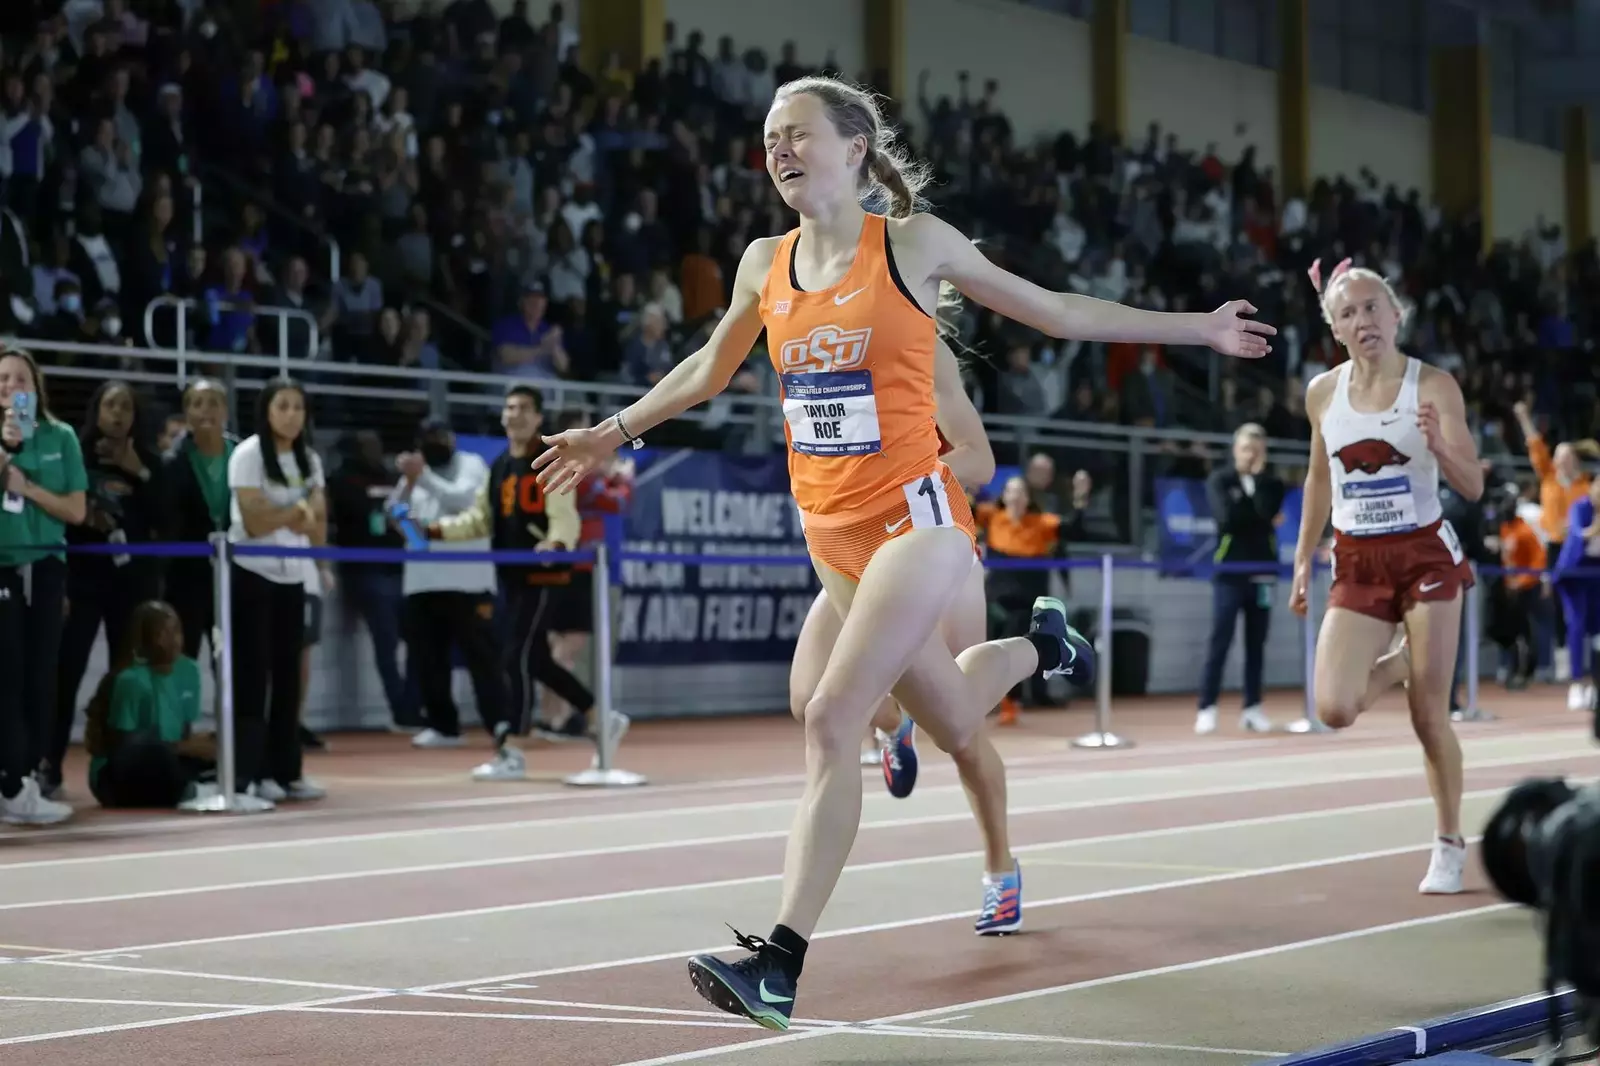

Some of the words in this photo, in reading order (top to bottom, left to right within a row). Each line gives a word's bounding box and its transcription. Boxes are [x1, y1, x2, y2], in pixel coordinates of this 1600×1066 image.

[781, 325, 872, 373] OSU
[803, 402, 846, 418] TAYLOR
[823, 383, 867, 394] CHAMPIONSHIPS
[813, 421, 842, 439] ROE
[661, 488, 785, 537] WELCOME
[917, 476, 943, 526] 1
[643, 594, 700, 641] AND
[702, 594, 774, 641] FIELD
